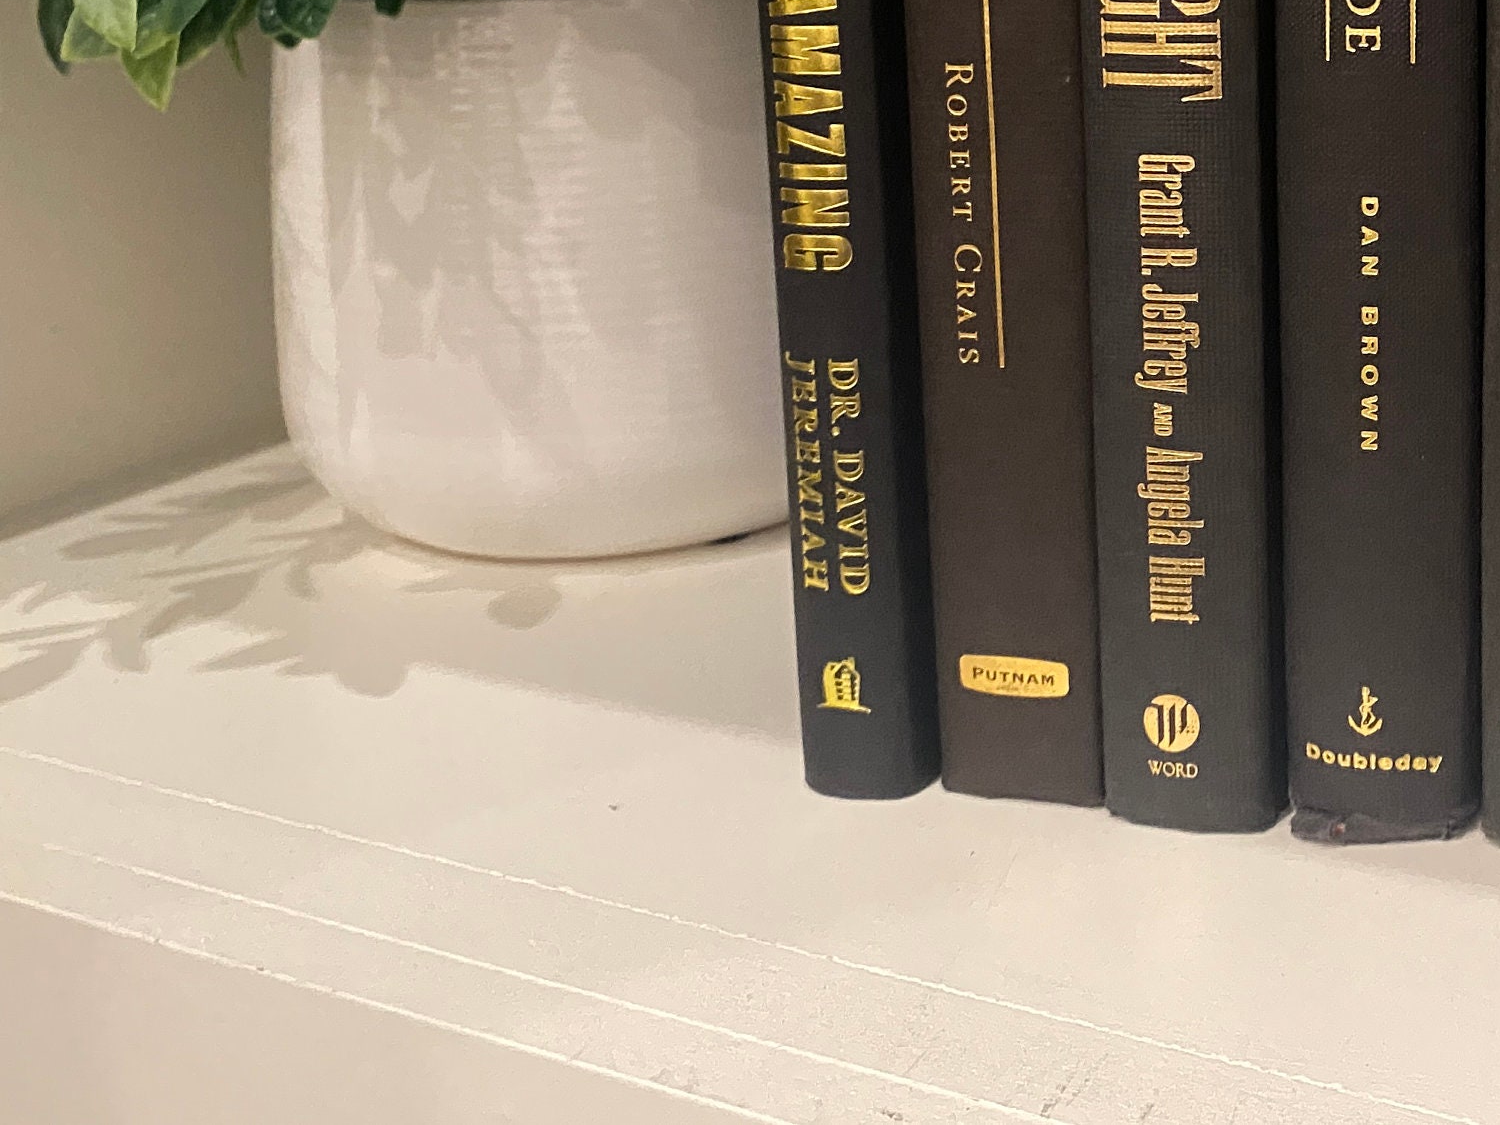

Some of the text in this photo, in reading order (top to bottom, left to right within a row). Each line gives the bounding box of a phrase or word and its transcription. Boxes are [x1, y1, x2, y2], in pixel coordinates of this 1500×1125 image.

[943, 62, 982, 363] ROBERT CRAIS
[1361, 197, 1379, 450] DAN BROWN
[785, 351, 829, 592] JEREMIAH
[828, 359, 869, 594] DR. DAVID
[1135, 155, 1205, 624] Grant R. Jeffrey AND Angela Hunt
[972, 666, 1055, 686] PUTNAM
[1148, 760, 1198, 778] WORD
[1306, 743, 1442, 773] Doubleday
